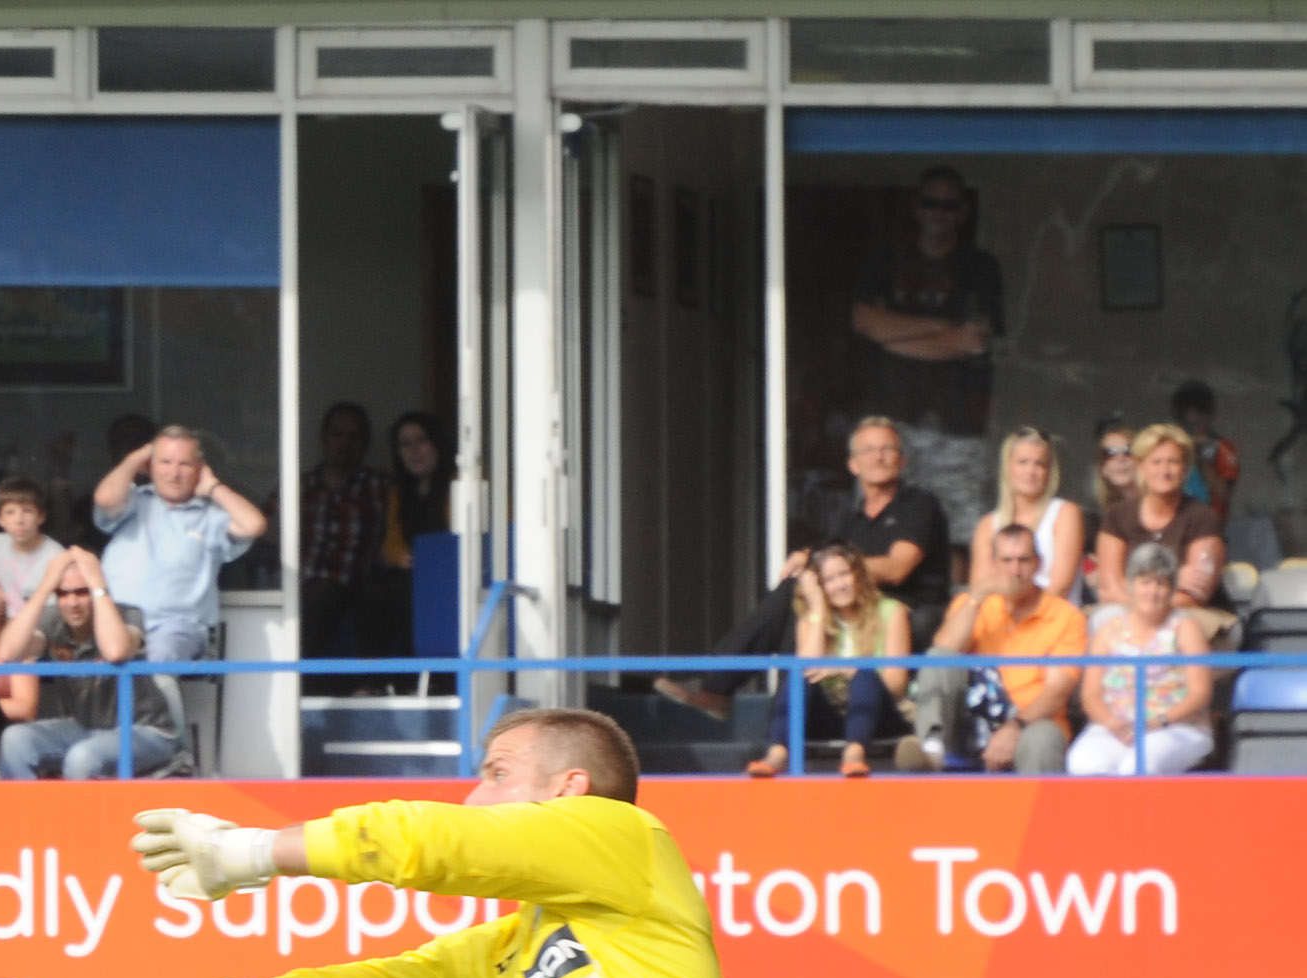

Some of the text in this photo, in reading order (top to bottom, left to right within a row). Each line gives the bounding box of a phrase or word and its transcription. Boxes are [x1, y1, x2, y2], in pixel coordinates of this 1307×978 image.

[153, 875, 499, 956] suppo
[693, 851, 882, 937] ton
[910, 846, 1179, 937] Town
